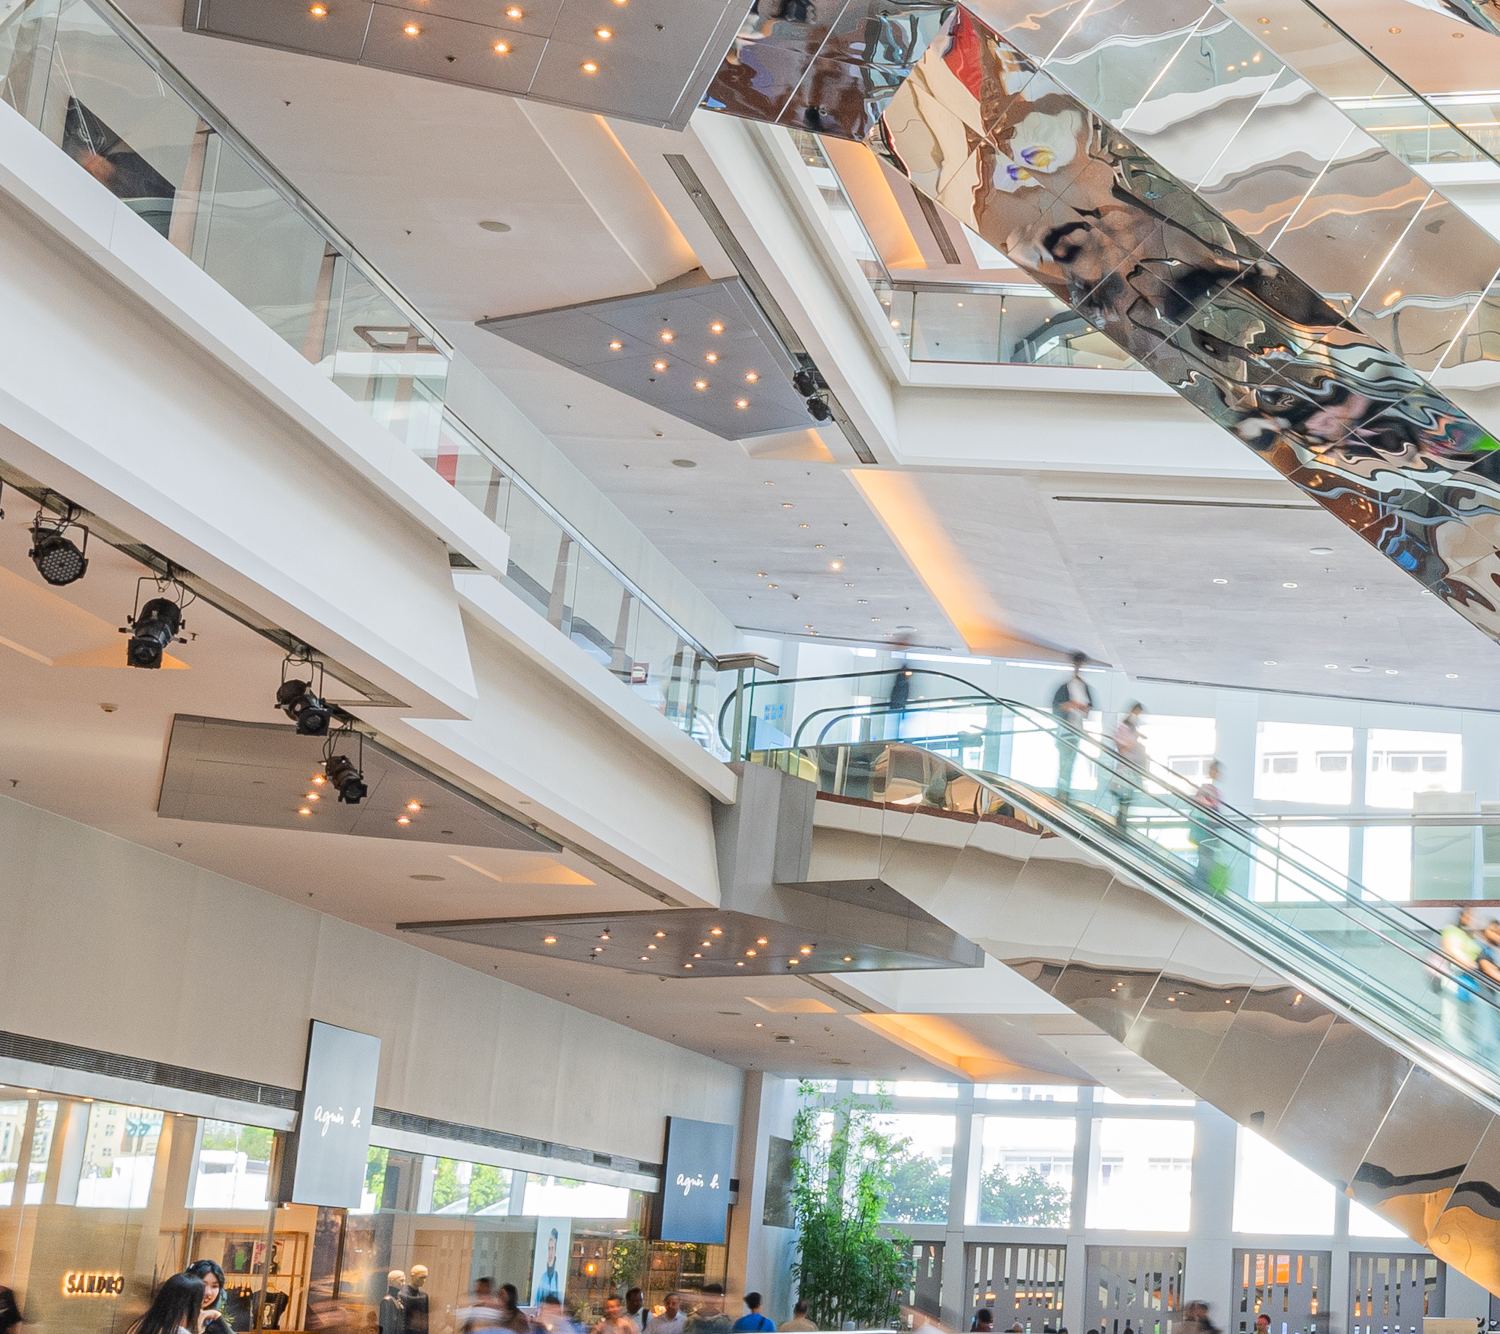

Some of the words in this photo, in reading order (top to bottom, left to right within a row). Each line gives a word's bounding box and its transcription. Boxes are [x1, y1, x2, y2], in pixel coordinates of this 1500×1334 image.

[676, 1173, 704, 1196] agnès
[710, 1173, 719, 1189] b.
[65, 1273, 125, 1295] SANDRO
